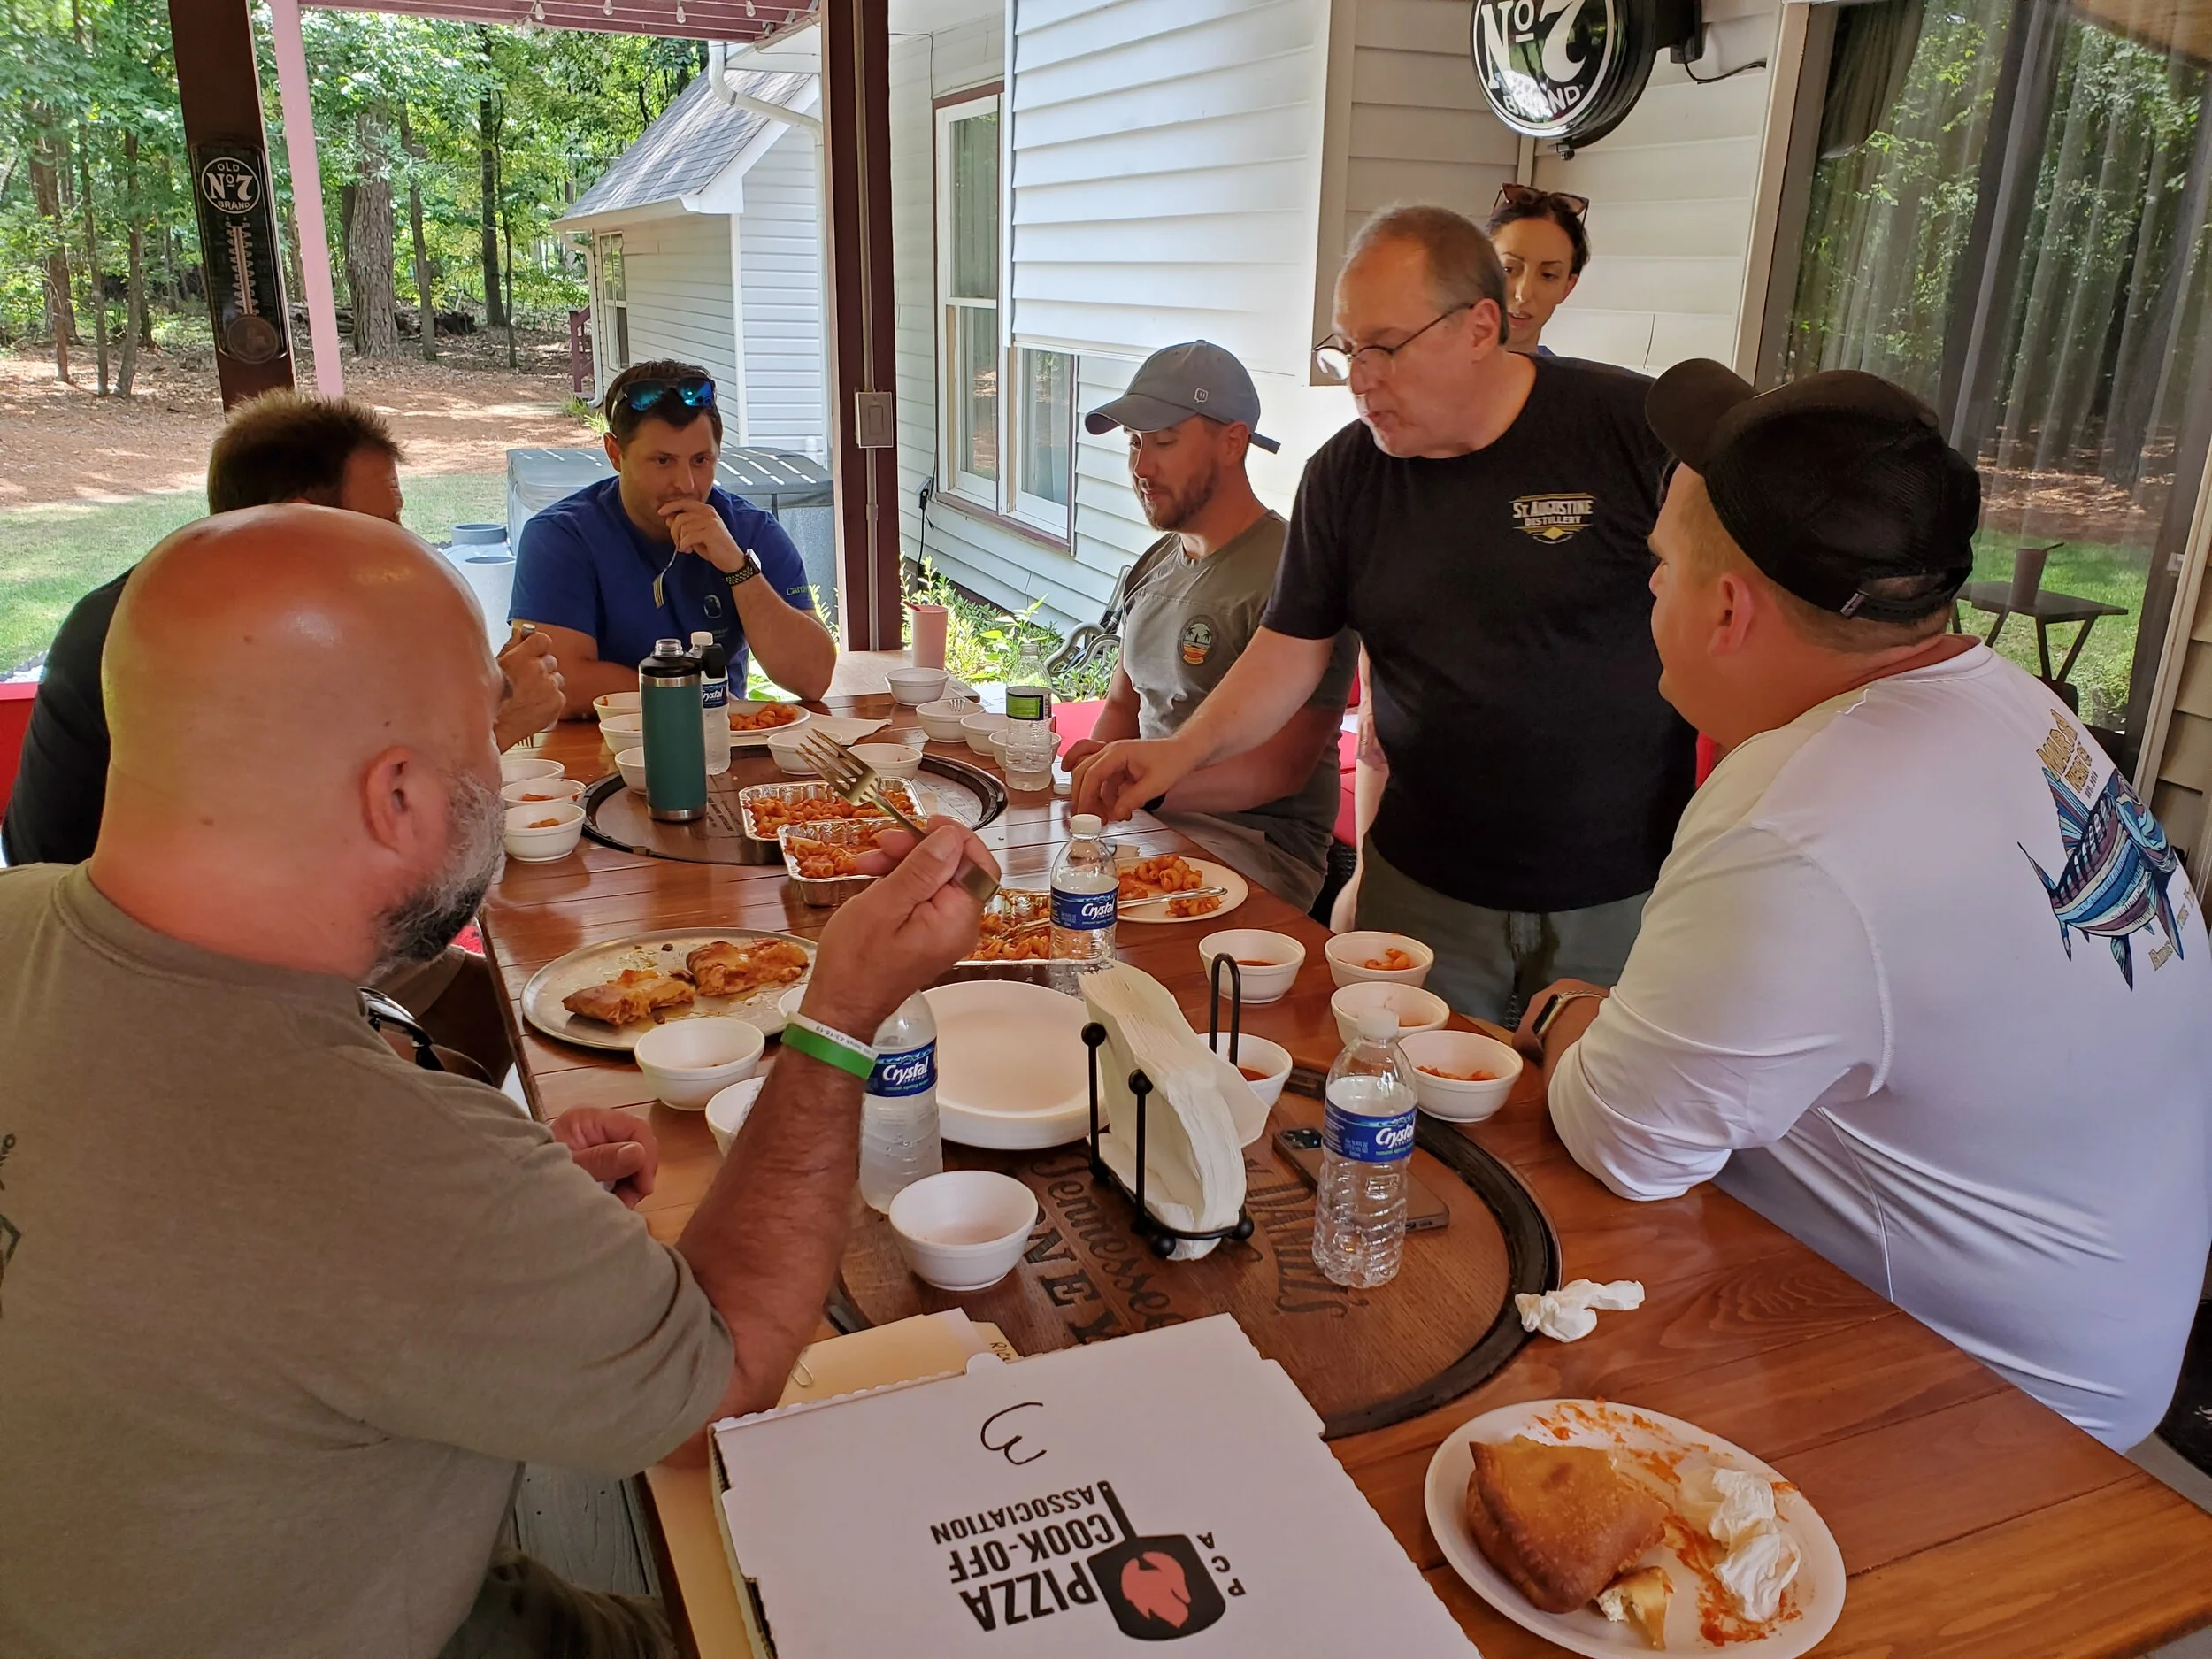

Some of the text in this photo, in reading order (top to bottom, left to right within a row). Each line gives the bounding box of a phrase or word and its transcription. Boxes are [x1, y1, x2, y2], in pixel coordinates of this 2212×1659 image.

[217, 162, 240, 173] OLD
[217, 200, 250, 211] BRAND
[702, 687, 724, 703] rystal
[1080, 898, 1116, 920] Crystal
[881, 1055, 929, 1086] Crystal
[979, 1401, 1048, 1466] 3
[930, 1485, 1096, 1545] ASSOCIATION
[949, 1513, 1116, 1585] COOK-OFF
[958, 1560, 1099, 1632] PIZZA
